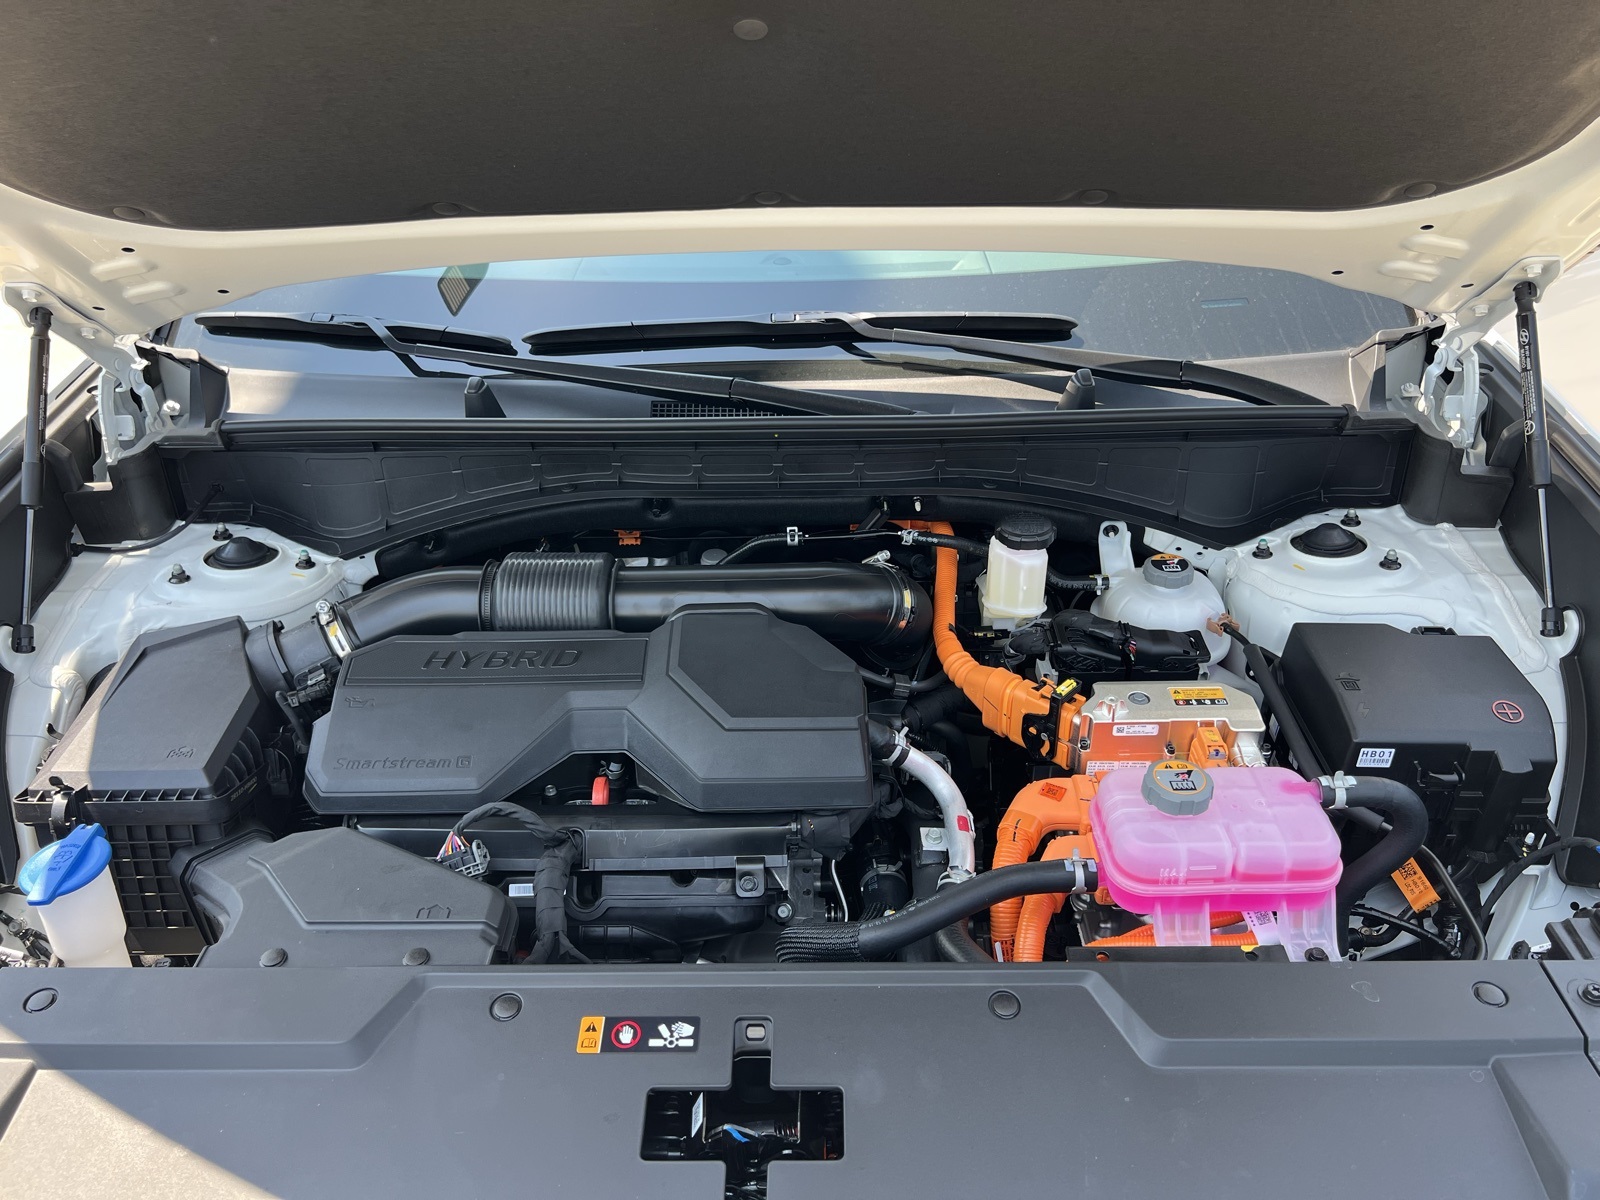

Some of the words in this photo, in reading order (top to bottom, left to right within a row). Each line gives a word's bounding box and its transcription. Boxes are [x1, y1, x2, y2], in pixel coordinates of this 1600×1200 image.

[421, 650, 583, 670] HYBRID
[1361, 750, 1393, 758] HB01
[333, 756, 452, 770] Smartstream
